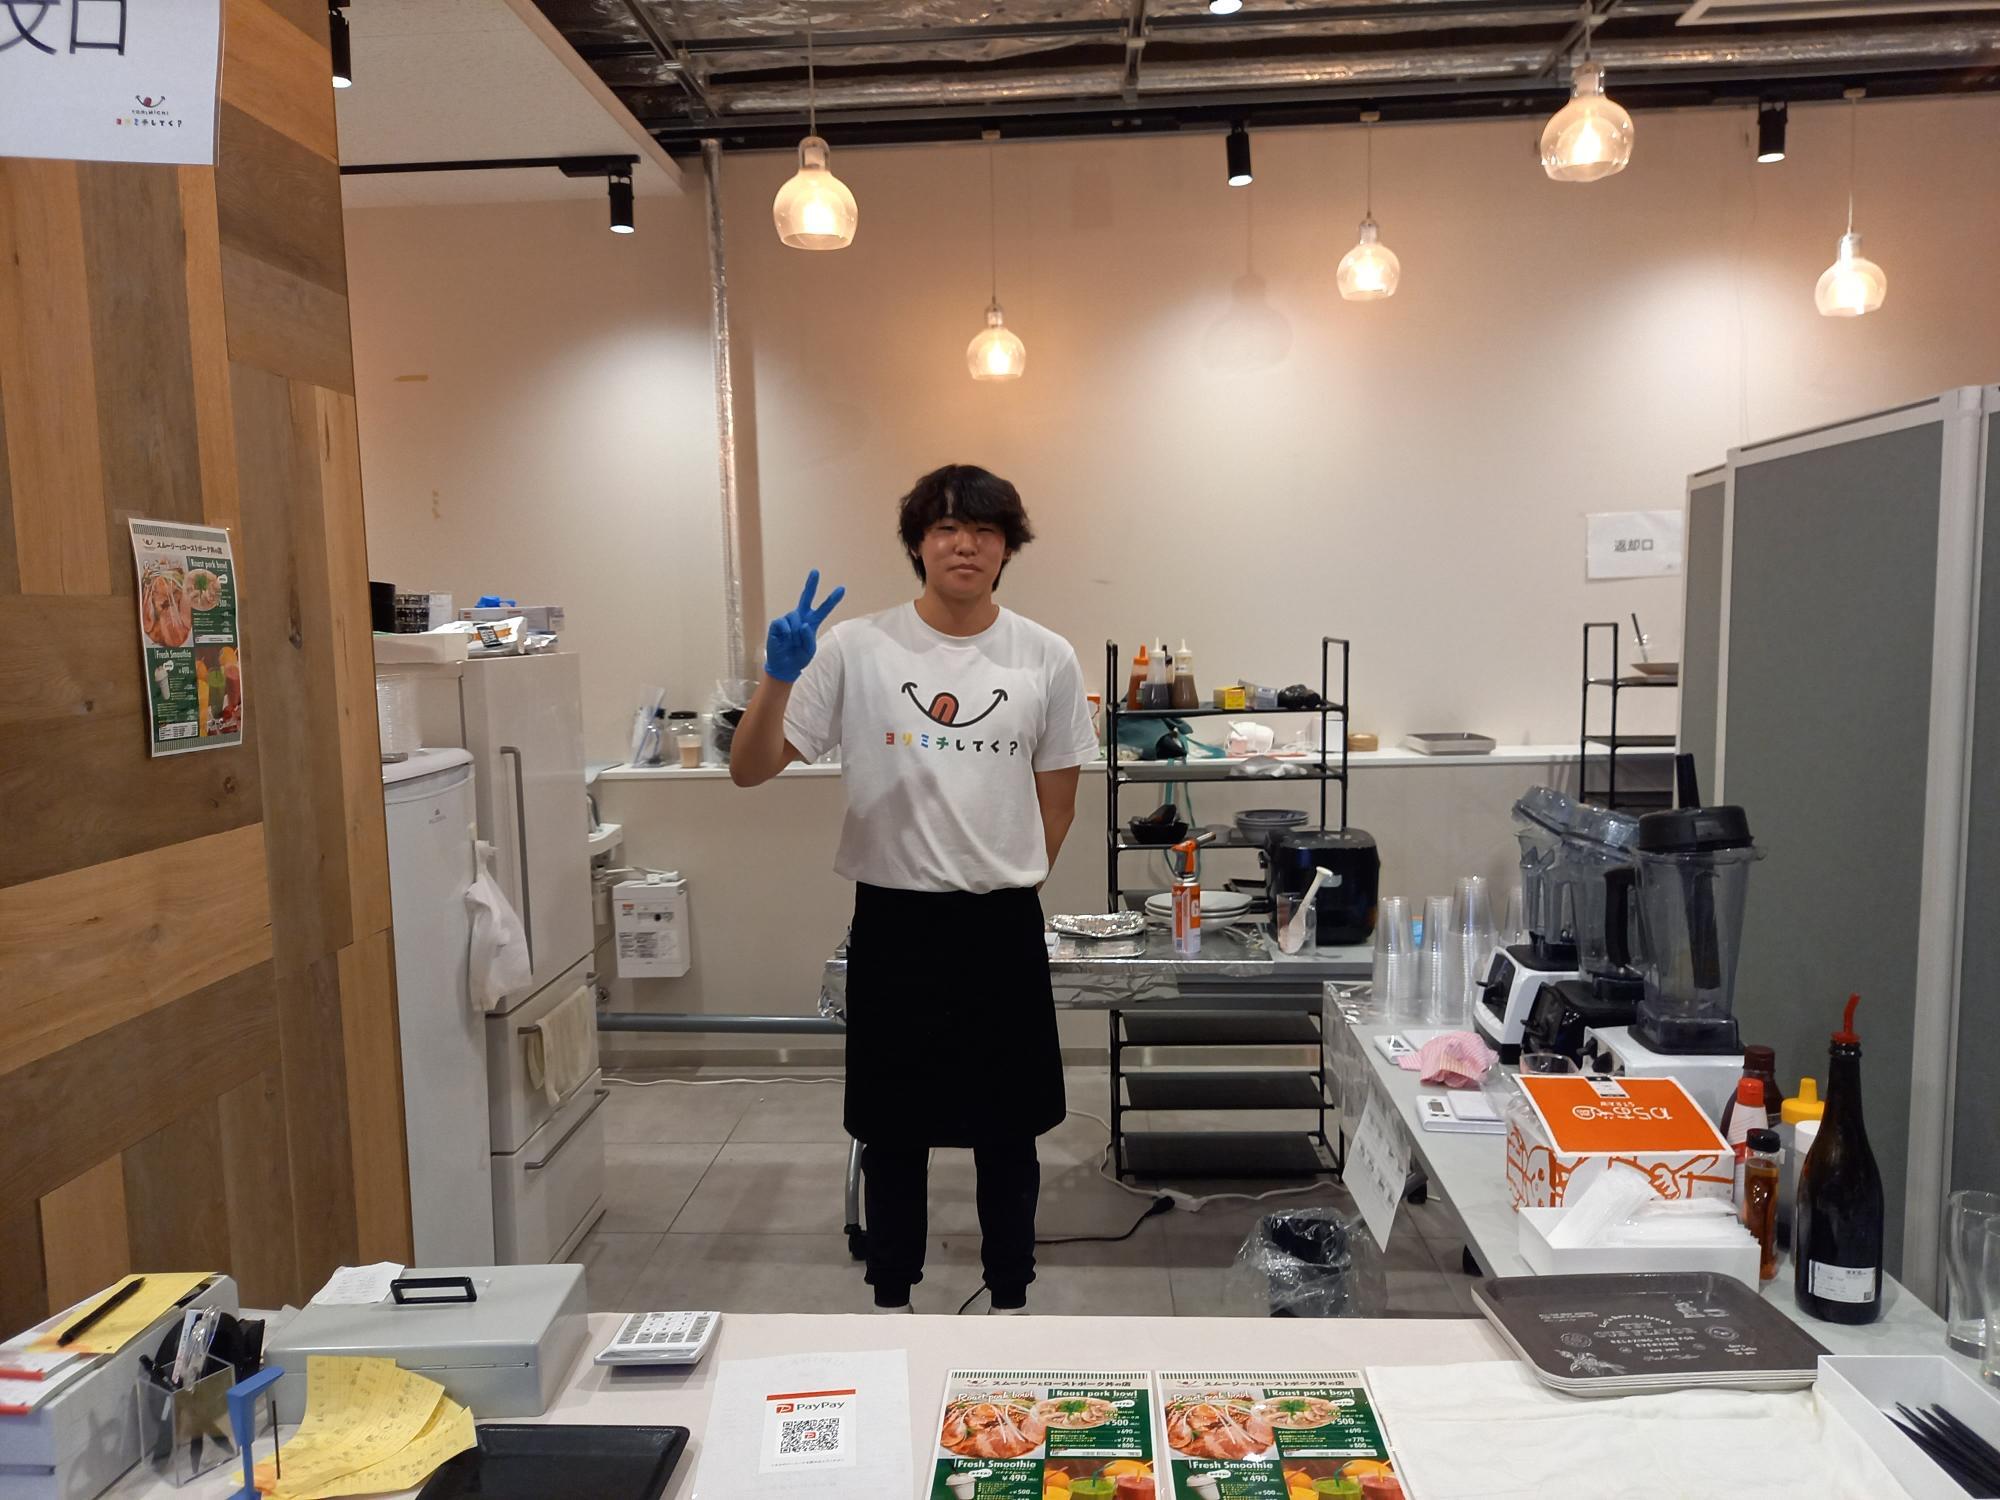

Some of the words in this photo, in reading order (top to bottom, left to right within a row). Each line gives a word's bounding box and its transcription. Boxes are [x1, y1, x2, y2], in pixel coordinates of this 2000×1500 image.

[1613, 538, 1654, 552] 返却口
[885, 732, 1018, 756] ヨリミチしてく?
[1087, 1390, 1111, 1398] pork
[1113, 1389, 1137, 1397] bowl
[1303, 1389, 1327, 1397] pork
[1329, 1388, 1355, 1397] bowl
[796, 1400, 845, 1411] PayPay
[957, 1459, 985, 1468] Fresh
[987, 1459, 1037, 1468] Smoothie
[1192, 1460, 1221, 1469] Fresh
[1223, 1460, 1274, 1470] Smoothie
